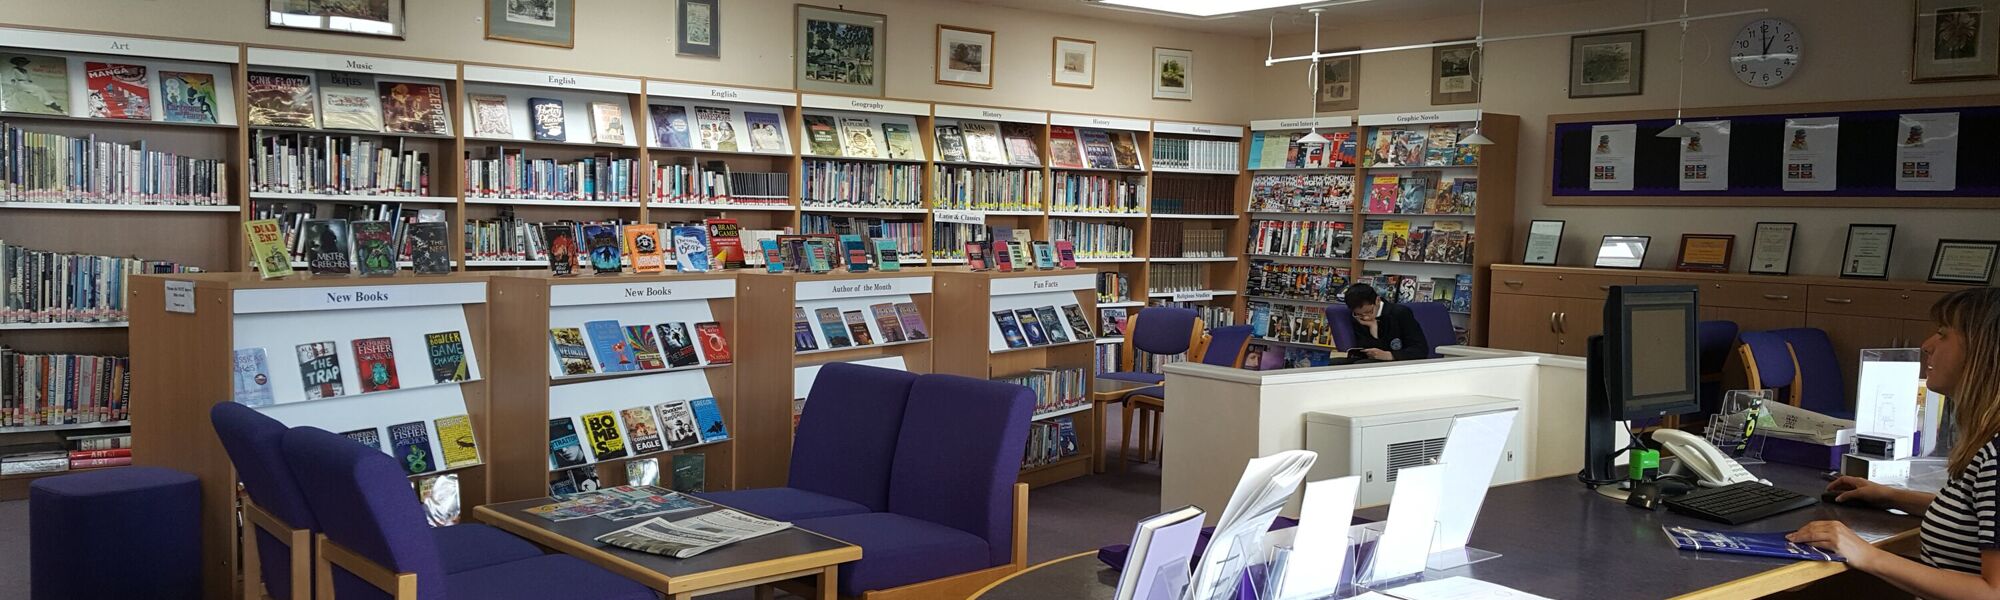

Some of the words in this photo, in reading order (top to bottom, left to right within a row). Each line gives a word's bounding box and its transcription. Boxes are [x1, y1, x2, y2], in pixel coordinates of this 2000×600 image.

[1748, 30, 1756, 39] 11
[1783, 33, 1791, 42] 2
[110, 41, 130, 50] Art
[1740, 39, 1750, 48] 10
[1786, 45, 1794, 53] 3
[346, 60, 373, 70] Music
[1740, 64, 1748, 73] 8
[88, 66, 129, 79] MANGA
[1749, 71, 1756, 80] 7
[1762, 73, 1770, 81] 6
[1775, 68, 1782, 76] 5
[548, 75, 576, 86] English
[711, 89, 737, 99] English
[851, 100, 885, 110] Geography
[982, 110, 1002, 119] History
[963, 122, 986, 131] ARMS
[253, 223, 277, 234] DEAD
[717, 223, 737, 231] BRAIN
[258, 233, 278, 243] END
[316, 252, 345, 261] MISTER
[832, 284, 852, 293] Author
[853, 284, 861, 292] of
[863, 283, 873, 291] the
[873, 283, 892, 291] Month
[1033, 280, 1044, 288] Fun
[1044, 280, 1059, 288] Facts
[327, 292, 351, 303] New
[355, 290, 389, 302] Books
[625, 288, 644, 297] New
[646, 286, 672, 296] Books
[1176, 292, 1195, 300] Religious
[358, 344, 392, 355] FISHER
[431, 343, 463, 357] GAME
[310, 357, 333, 370] THE
[306, 366, 340, 385] TRAP
[588, 414, 615, 430] BO
[393, 428, 428, 441] FISHER
[592, 427, 619, 443] MB
[635, 440, 661, 451] EAGLE
